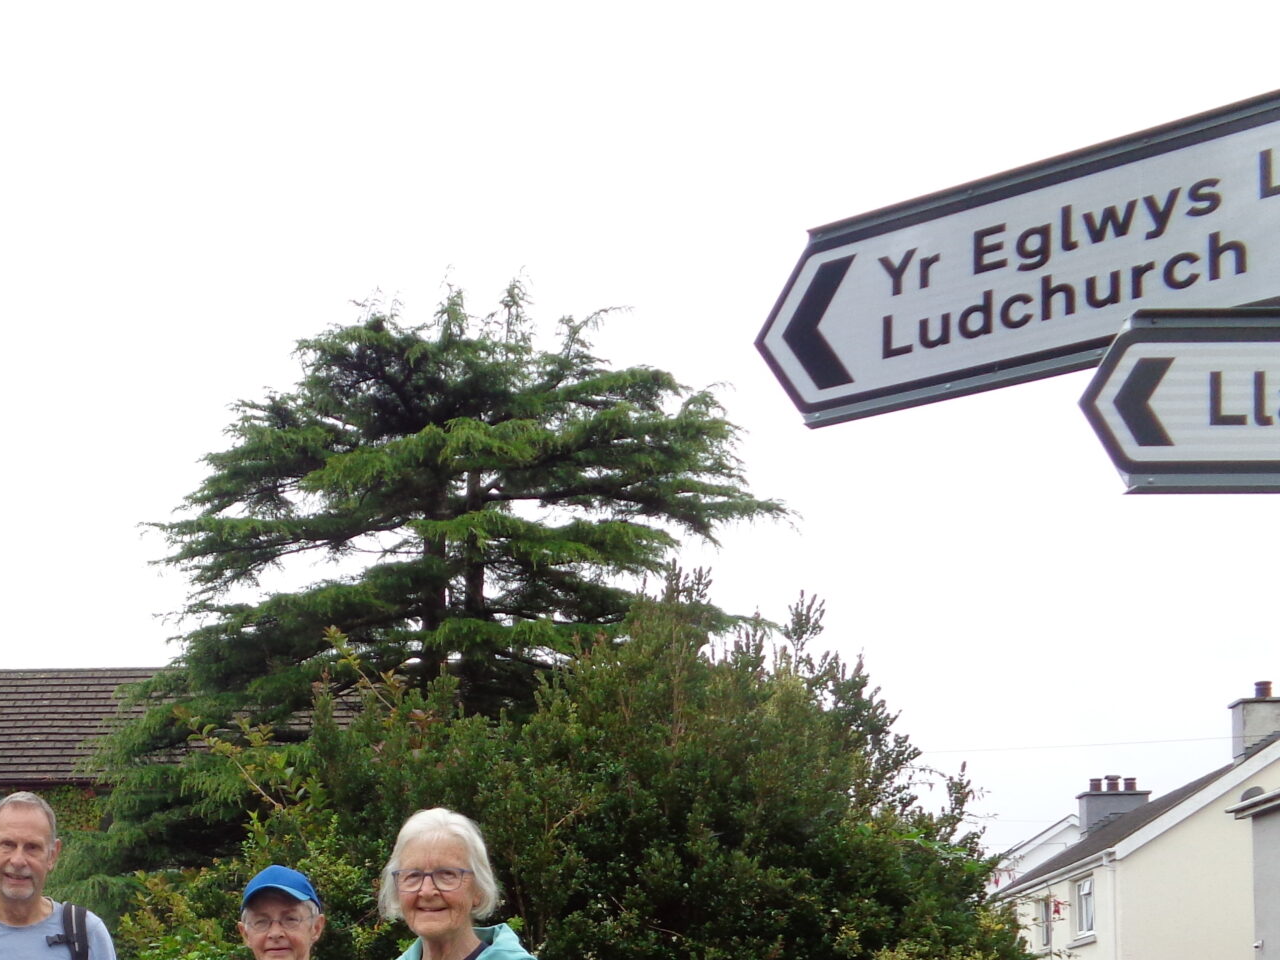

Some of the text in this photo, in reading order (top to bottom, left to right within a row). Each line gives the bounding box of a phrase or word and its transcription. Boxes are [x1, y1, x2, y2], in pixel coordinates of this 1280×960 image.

[877, 248, 940, 296] Yr
[973, 176, 1222, 275] Eglwys
[881, 231, 1248, 360] Ludchurch
[1208, 370, 1280, 426] Ll
